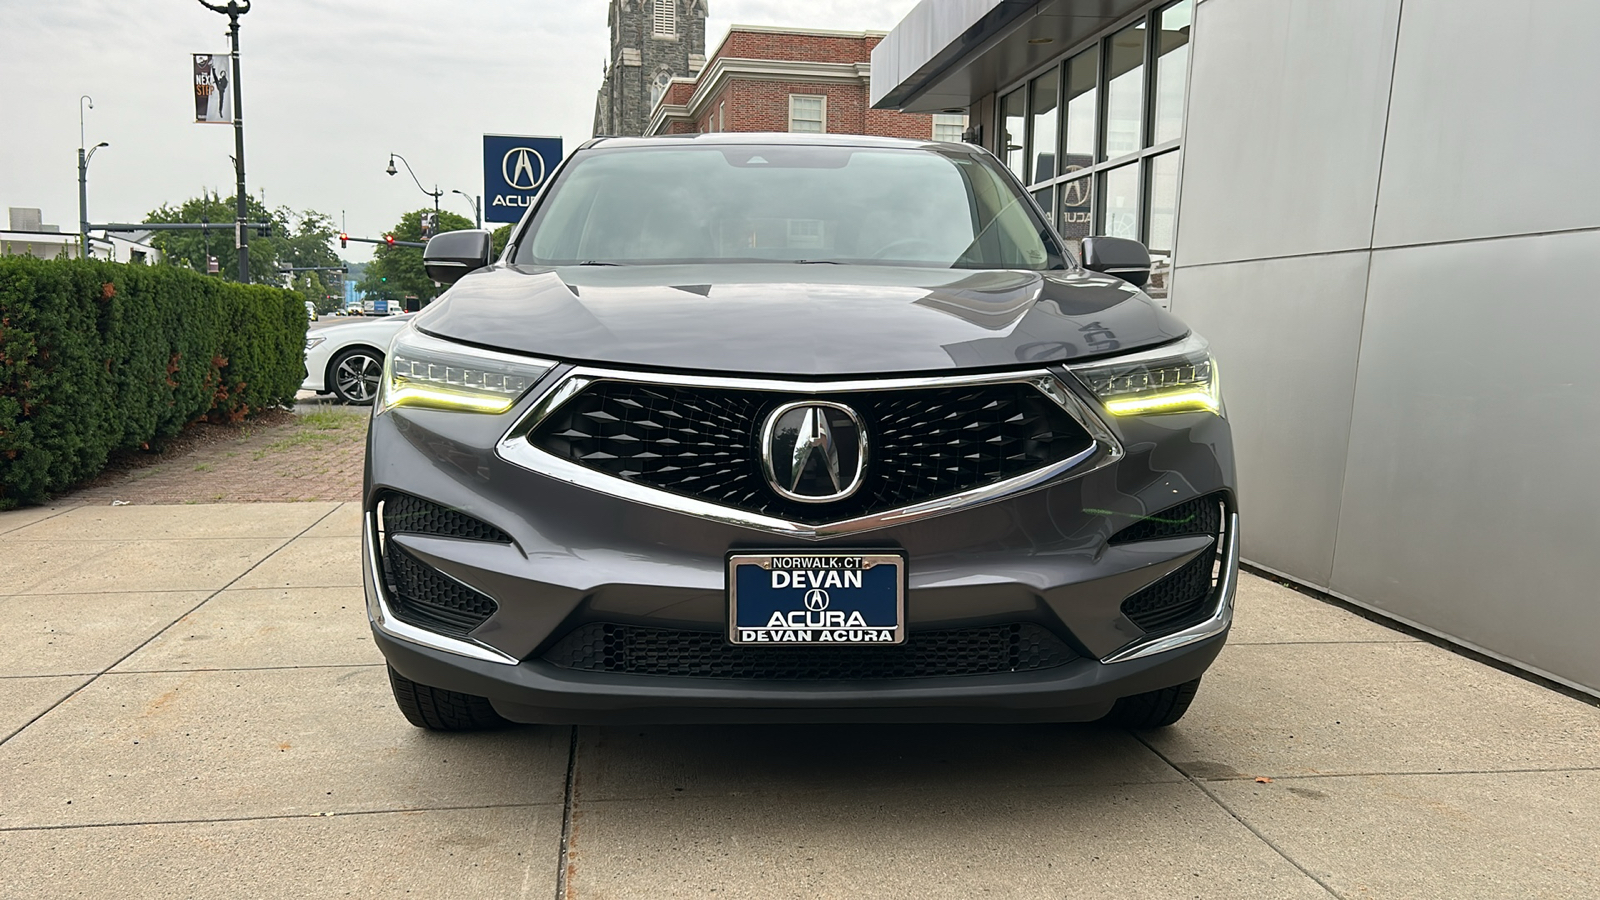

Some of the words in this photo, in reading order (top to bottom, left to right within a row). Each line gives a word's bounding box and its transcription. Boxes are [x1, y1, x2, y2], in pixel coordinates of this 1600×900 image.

[196, 85, 214, 95] STEP
[844, 557, 862, 568] CT
[772, 570, 862, 588] DEVAN
[766, 611, 867, 627] ACURA
[742, 630, 812, 642] DEVAN
[818, 630, 893, 642] ACURA
